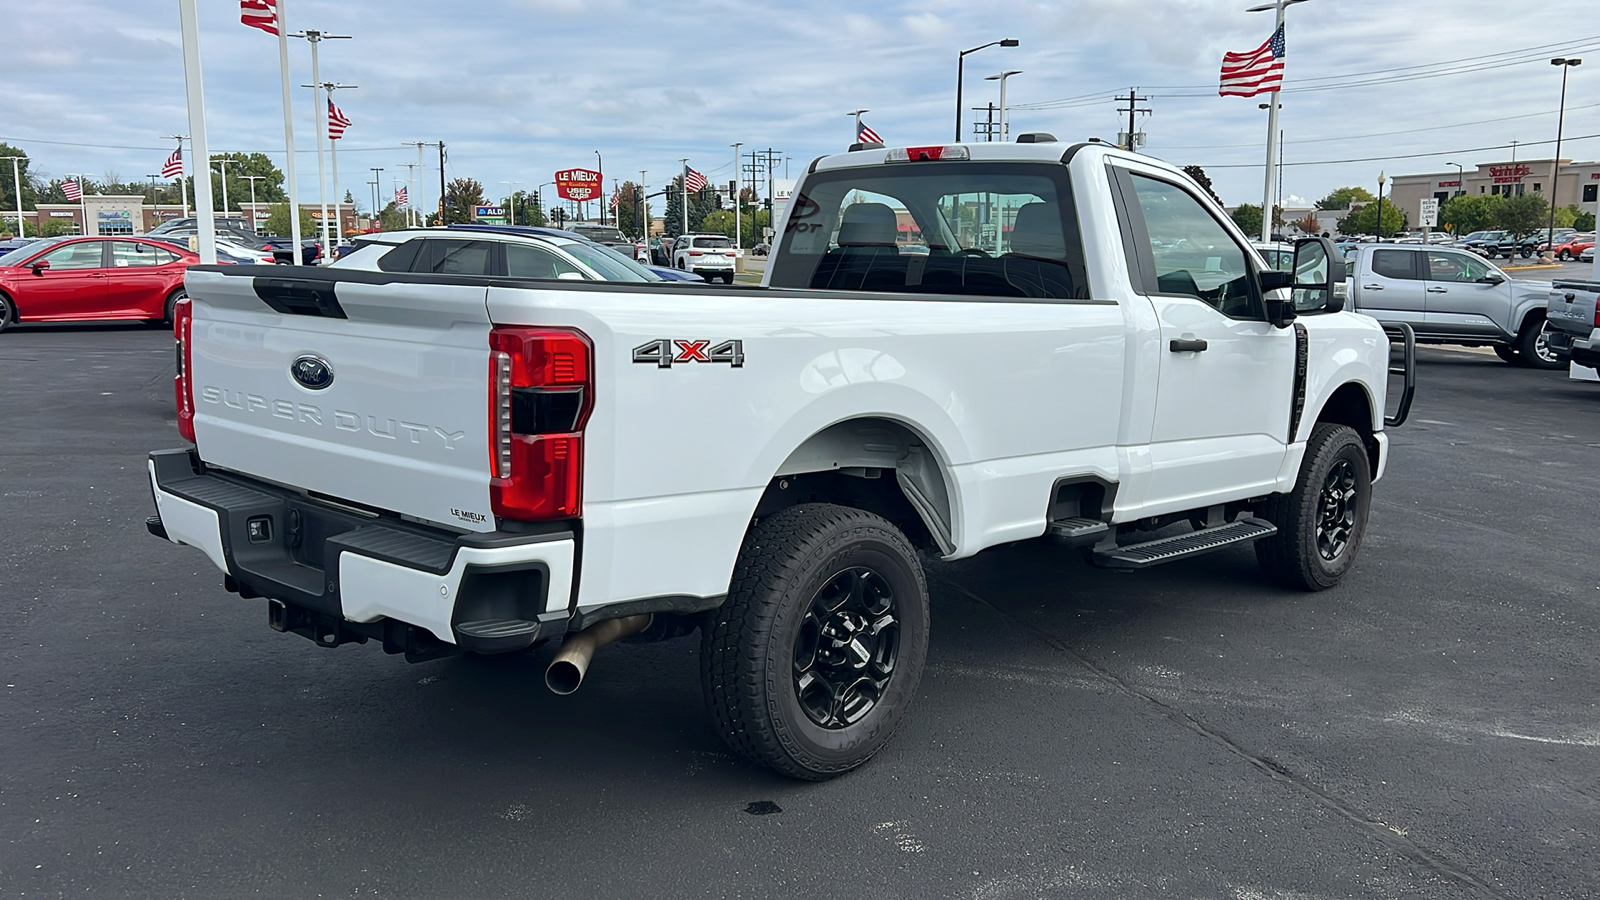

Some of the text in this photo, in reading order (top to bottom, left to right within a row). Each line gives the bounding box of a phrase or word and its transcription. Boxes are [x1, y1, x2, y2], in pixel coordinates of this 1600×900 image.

[559, 170, 598, 181] LE MIEUX
[487, 208, 506, 216] ALDI
[203, 385, 466, 451] SUPER DUTY
[450, 508, 487, 523] LE MIEUX
